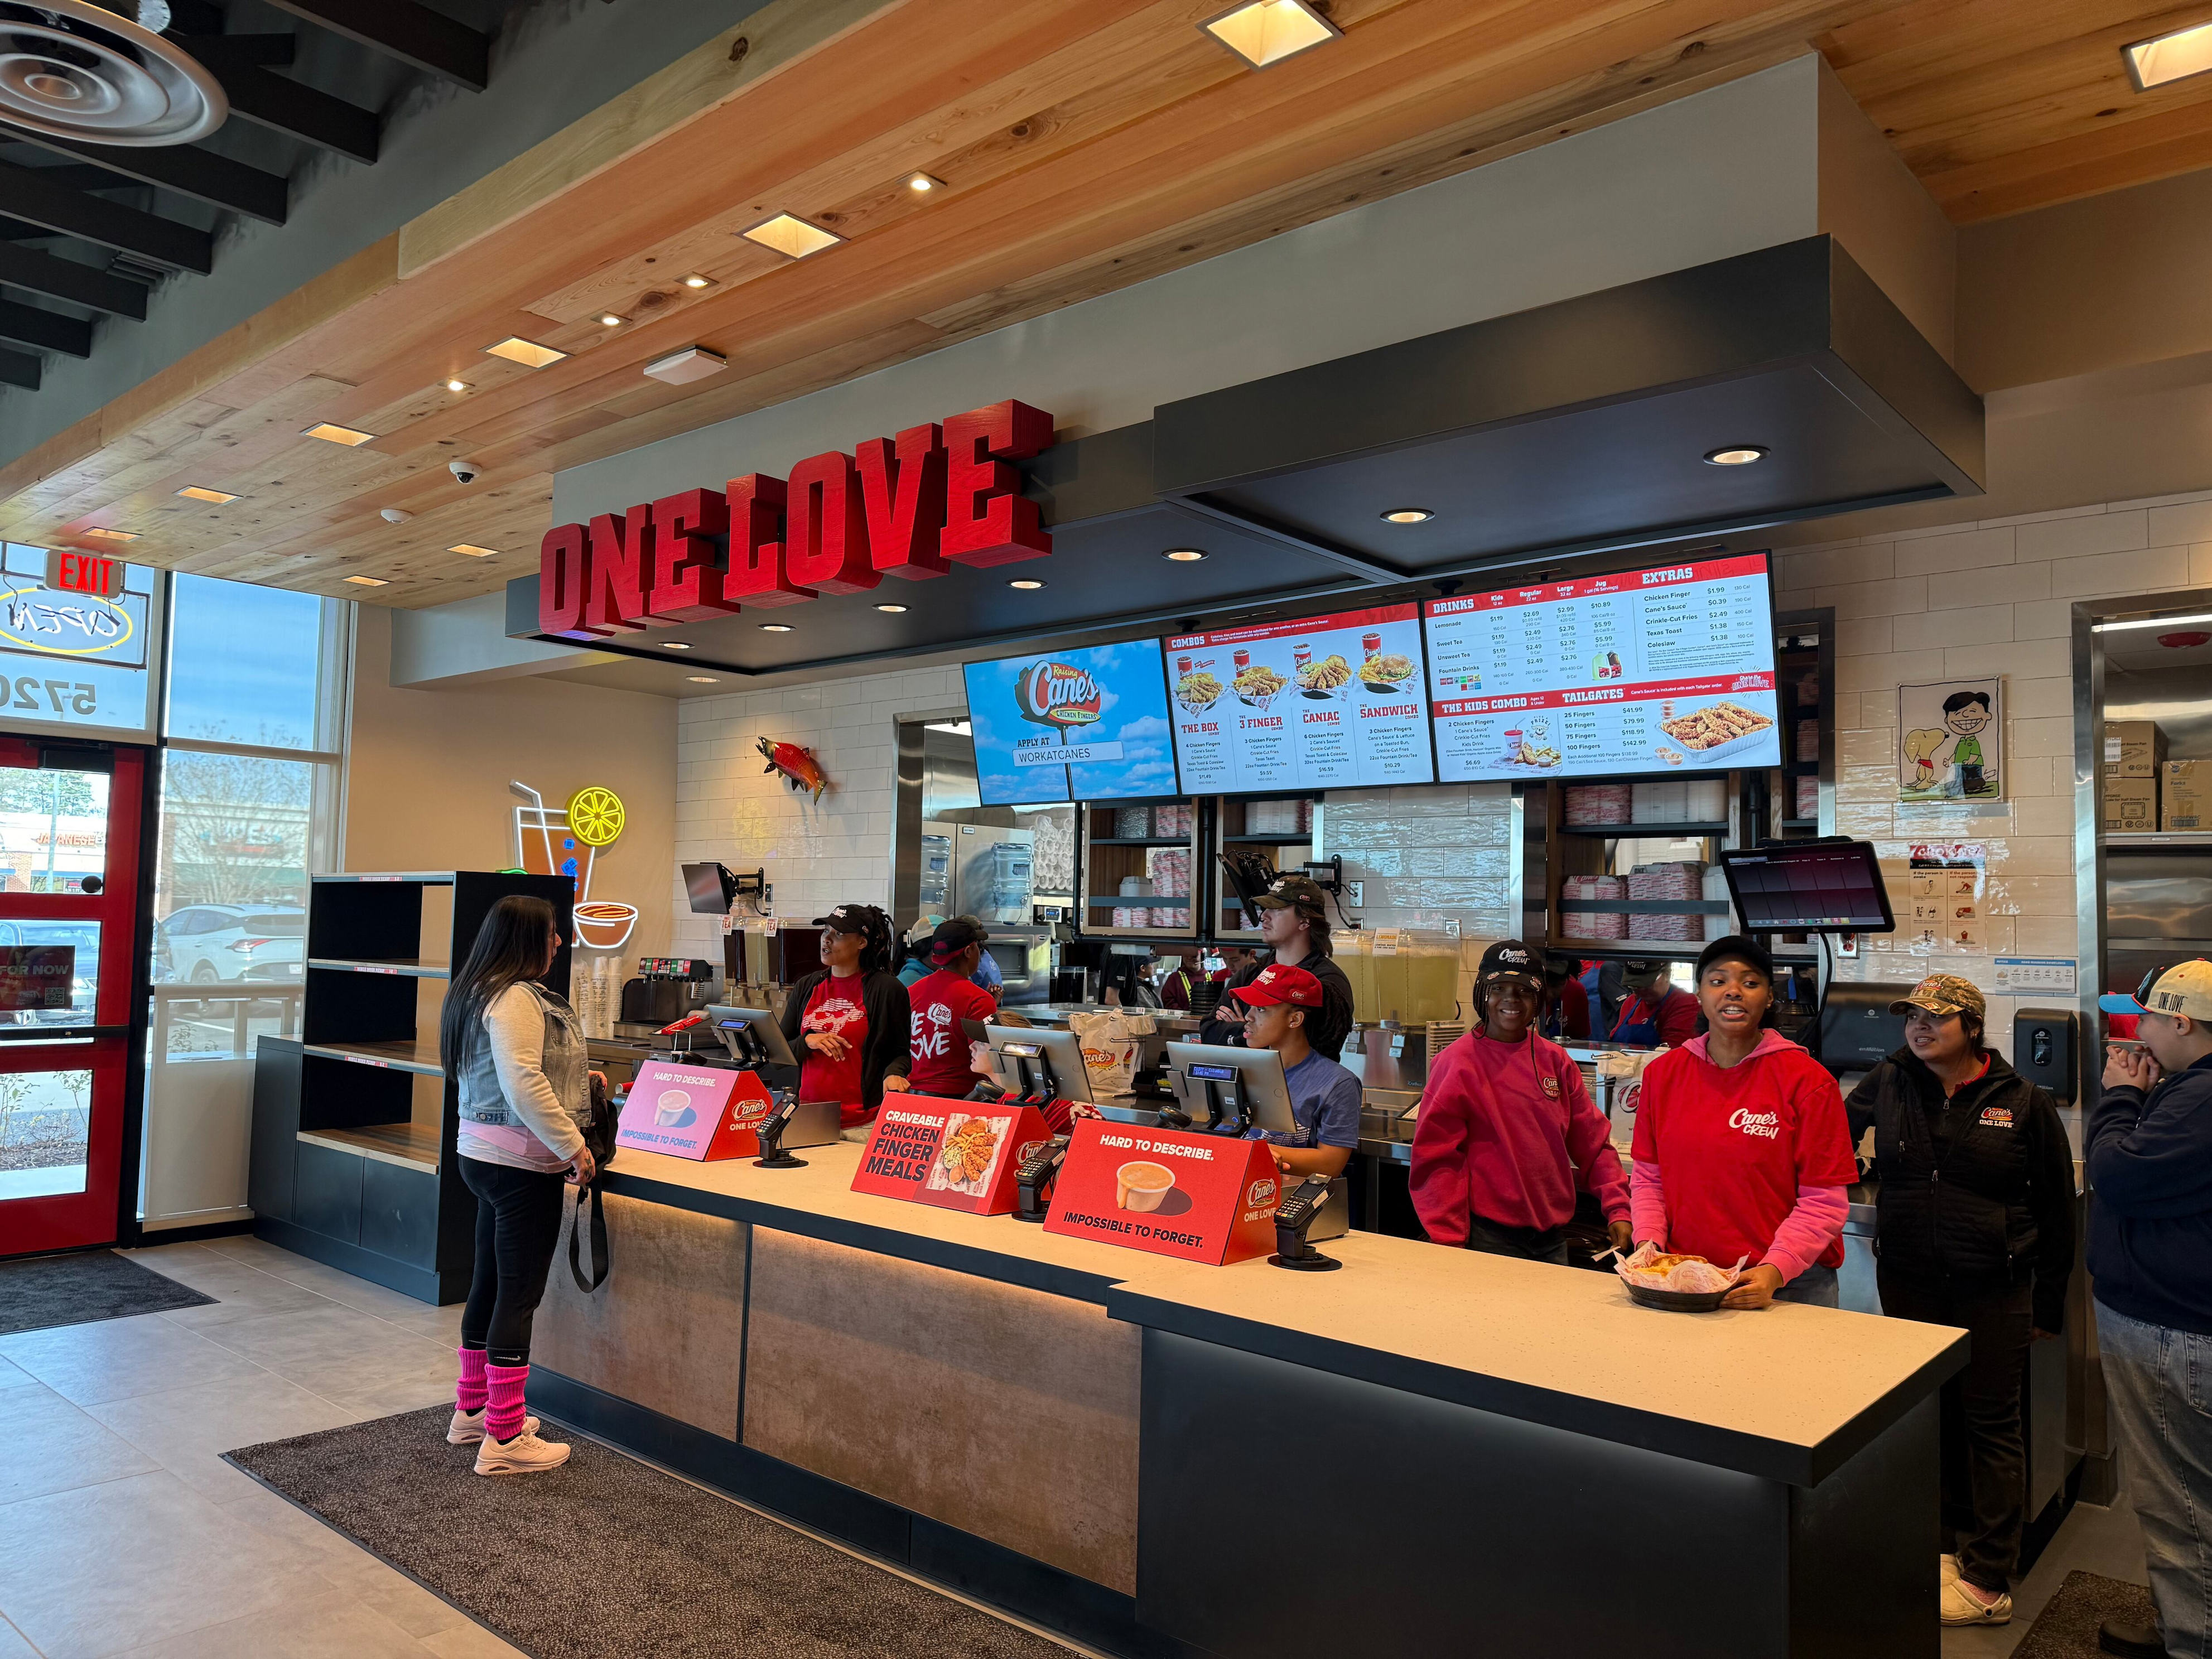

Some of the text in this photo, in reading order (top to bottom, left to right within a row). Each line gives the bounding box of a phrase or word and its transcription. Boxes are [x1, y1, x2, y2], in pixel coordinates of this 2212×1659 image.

[539, 399, 1054, 640] ONE LOVE
[59, 552, 114, 595] EXIT
[1642, 567, 1693, 584] EXTRAS
[1433, 599, 1474, 614] DRINKS
[1646, 616, 1680, 625] Crinkle-Cut
[1172, 636, 1204, 648] COMBOS
[1053, 666, 1078, 679] Raising
[1029, 660, 1099, 717] Cane's
[1732, 679, 1769, 689] ONE LOVE
[1563, 688, 1624, 703] TAILGATES
[1360, 704, 1418, 718] SANDWICH
[1442, 697, 1527, 713] THE KIDS COMBO
[1057, 710, 1097, 720] CHICKEN FINGERS
[1240, 716, 1283, 729] 3 FINGER
[1303, 711, 1339, 724] CANIAC
[1182, 722, 1219, 734] THE BOX
[1018, 737, 1049, 747] APPLY AT
[1019, 747, 1091, 763] WORKATCANES
[37, 833, 95, 846] JAANESE
[1499, 948, 1527, 960] Cane's
[0, 965, 69, 975] FOR NOW
[2158, 992, 2185, 1012] ONE LOVE
[931, 1004, 951, 1018] Cane's
[1083, 1049, 1113, 1063] ane's
[653, 1072, 672, 1081] HARD
[682, 1075, 715, 1087] DESCRIBE.
[734, 1099, 767, 1120] Cane's
[1981, 1107, 2012, 1118] Cane's
[885, 1110, 945, 1127] CRAVEABLE
[1729, 1108, 1779, 1128] Cane's
[621, 1129, 659, 1142] IMPOSSIBLE
[669, 1137, 697, 1149] FORGET.
[881, 1123, 940, 1143] CHICKEN
[1743, 1124, 1779, 1139] CREW
[873, 1138, 933, 1161] FINGER
[1100, 1134, 1214, 1161] HARD TO DESCRIBE.
[866, 1156, 928, 1181] MEALS
[1247, 1180, 1276, 1206] Cane's
[1244, 1212, 1258, 1222] ONE
[1063, 1212, 1203, 1248] IMPOSSIBLE TO FORGET.
